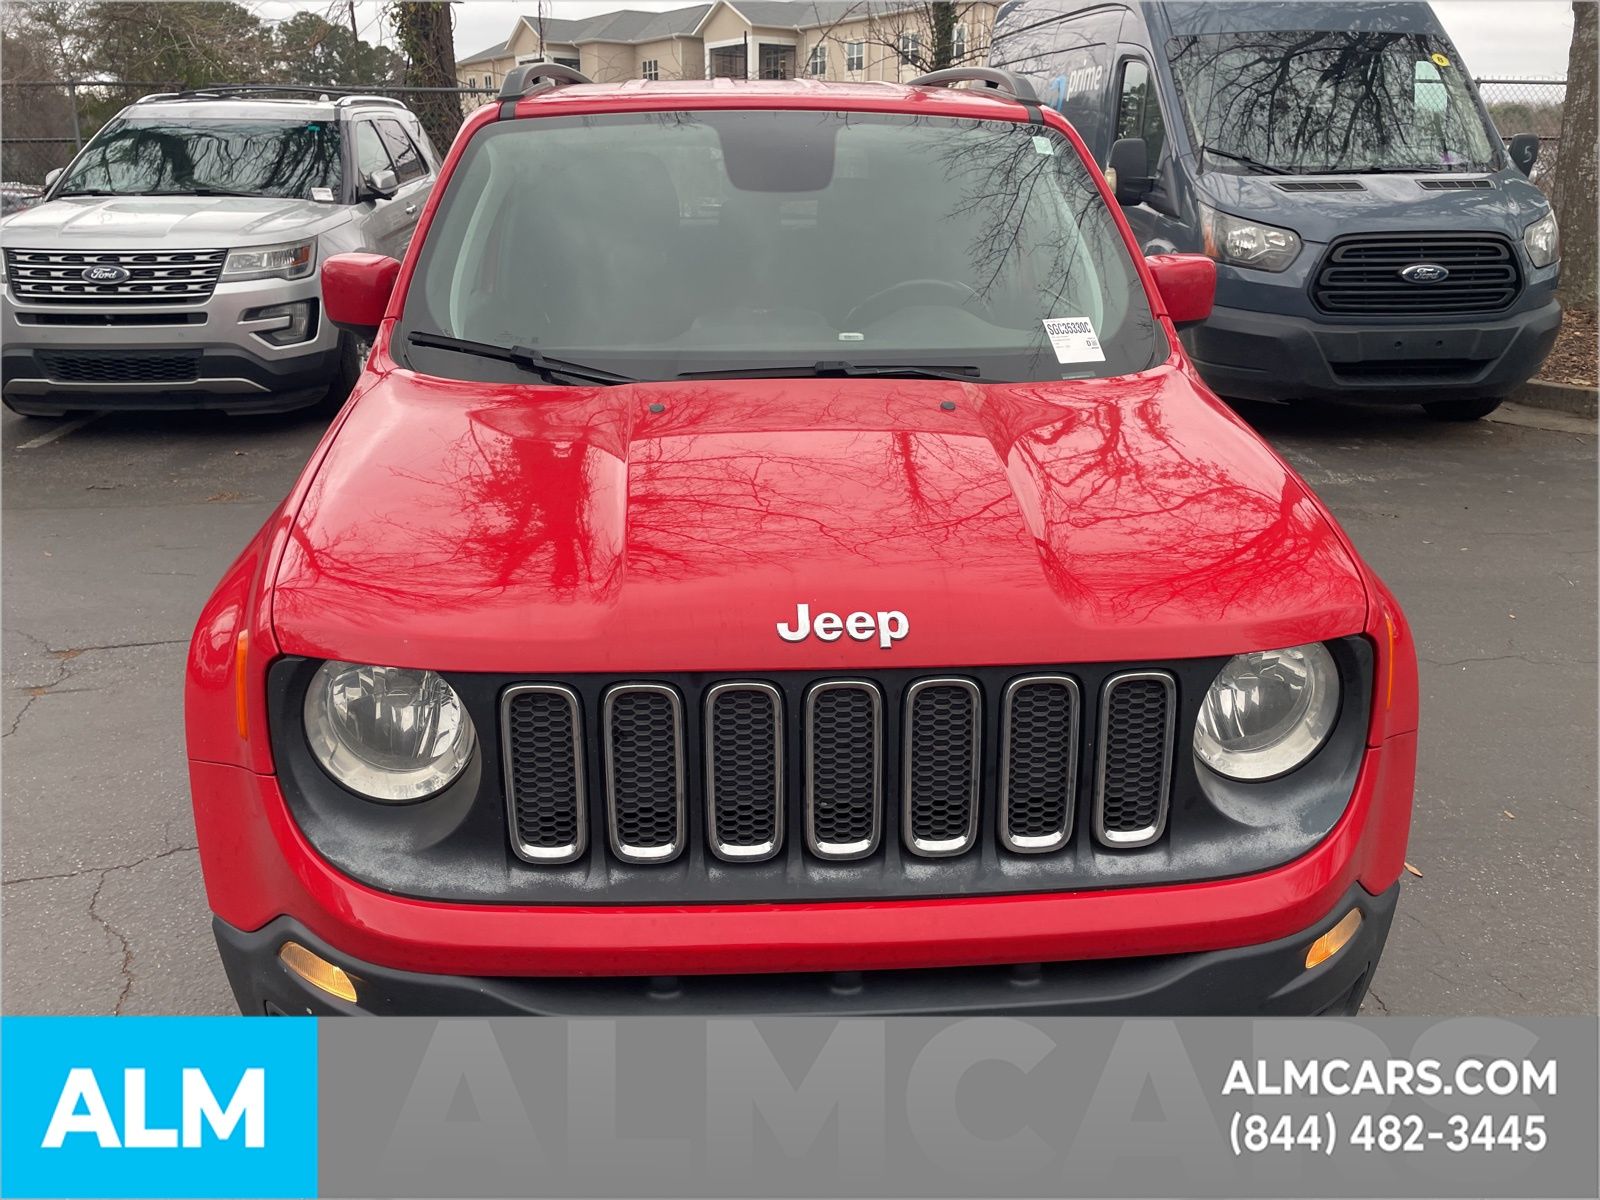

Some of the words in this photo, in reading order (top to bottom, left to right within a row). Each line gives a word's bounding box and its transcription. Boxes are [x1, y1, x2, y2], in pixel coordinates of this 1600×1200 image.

[1066, 59, 1103, 102] prime
[90, 268, 117, 279] Ford
[1413, 268, 1440, 279] Ford
[776, 603, 909, 649] Jeep
